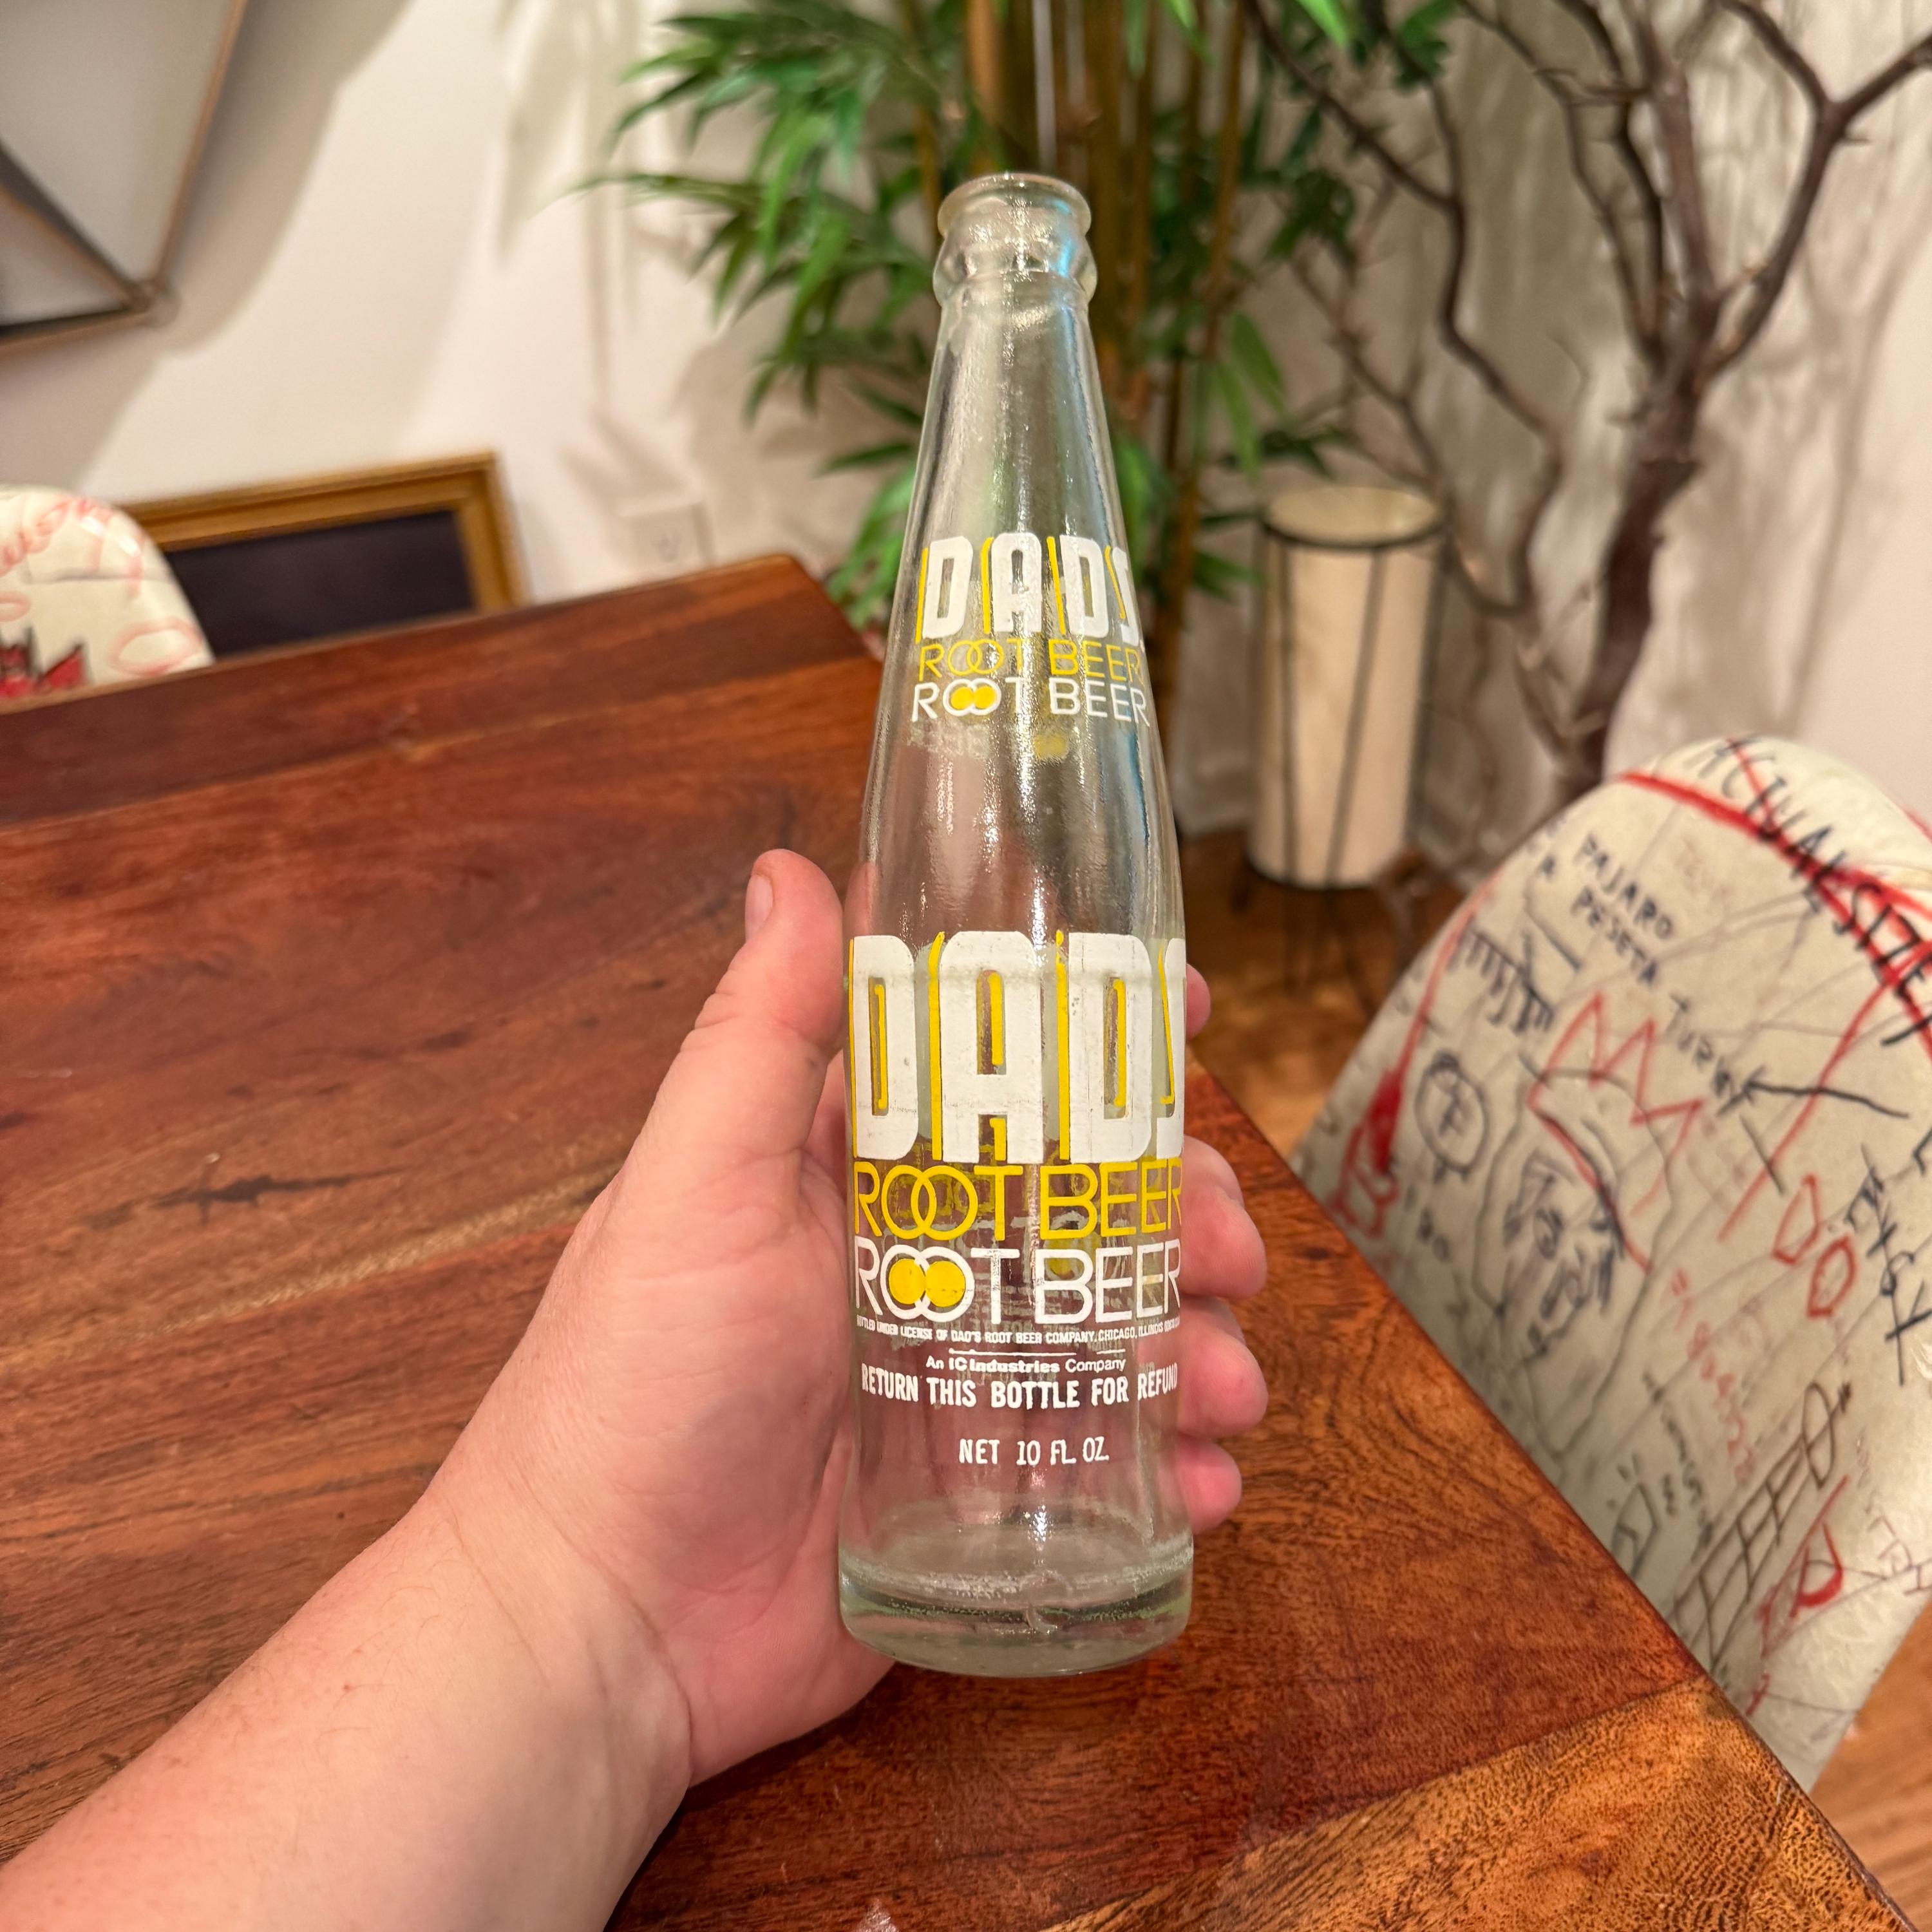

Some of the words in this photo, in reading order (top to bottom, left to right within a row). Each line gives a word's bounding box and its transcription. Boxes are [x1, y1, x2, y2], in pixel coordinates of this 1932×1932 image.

[918, 638, 1023, 682] ROOT
[1048, 639, 1144, 685] BEER
[912, 677, 1026, 723] ROOT
[1049, 677, 1150, 726] BEER
[854, 1161, 1023, 1242] ROOT
[1040, 1157, 1182, 1240] BEER
[854, 1235, 1021, 1325] ROOT
[1034, 1238, 1181, 1325] BEER
[876, 1321, 898, 1336] UNDER
[900, 1325, 933, 1340] LICENSE
[936, 1329, 949, 1341] OF
[951, 1330, 981, 1343] DAD'S
[985, 1331, 1012, 1344] ROOT
[1016, 1332, 1042, 1345] BEER
[1138, 1321, 1164, 1338] ILLINOIS
[861, 1363, 919, 1402] RETURN
[926, 1377, 977, 1408] THIS
[991, 1380, 1081, 1410] BOTTLE
[1092, 1376, 1129, 1406] FOR
[1137, 1362, 1179, 1401] REFUND
[926, 1356, 944, 1370] An
[949, 1357, 968, 1371] IC
[970, 1358, 1061, 1373] Industries
[1065, 1358, 1127, 1373] Company
[958, 1438, 1000, 1465] NET
[1016, 1441, 1041, 1466] 10
